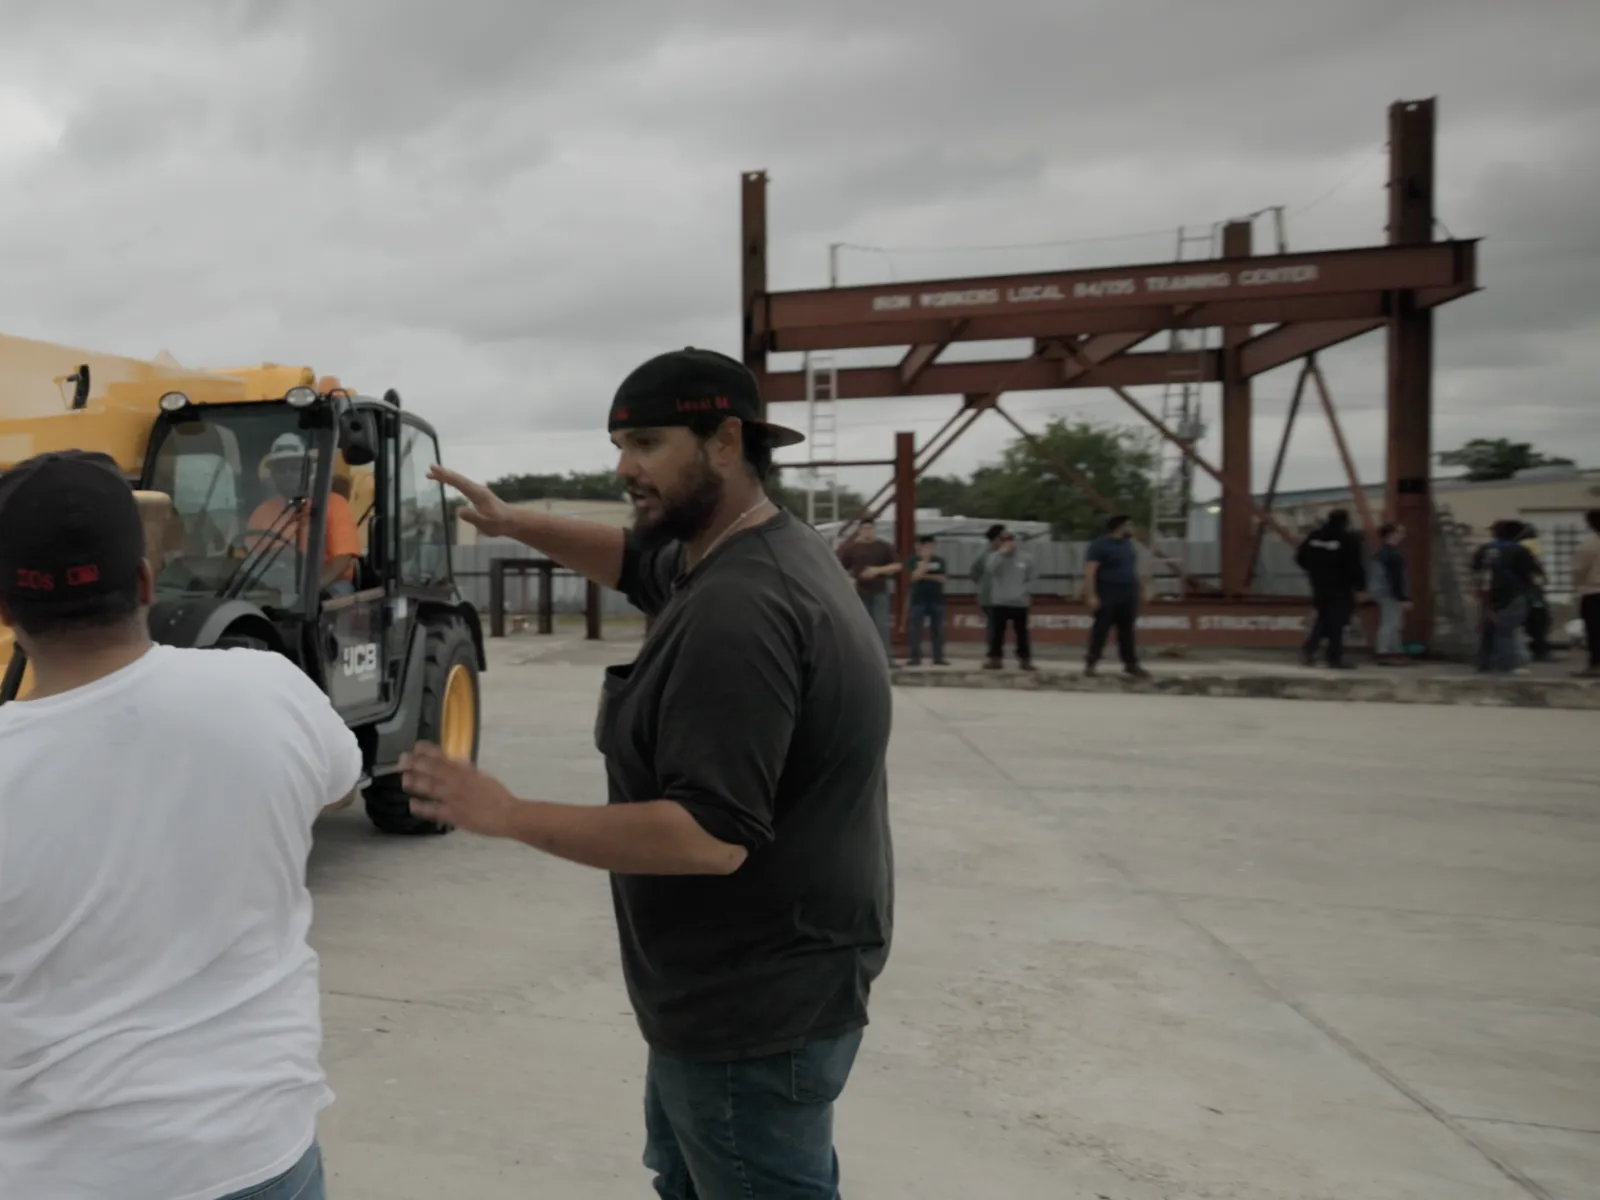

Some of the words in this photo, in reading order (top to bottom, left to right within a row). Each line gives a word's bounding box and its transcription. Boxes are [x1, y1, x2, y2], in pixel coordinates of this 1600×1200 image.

[920, 288, 999, 307] WORKERS
[1006, 284, 1065, 303] LOCAL
[1145, 272, 1231, 292] TRAINING
[1238, 264, 1319, 286] CENTER
[343, 643, 377, 677] JCB
